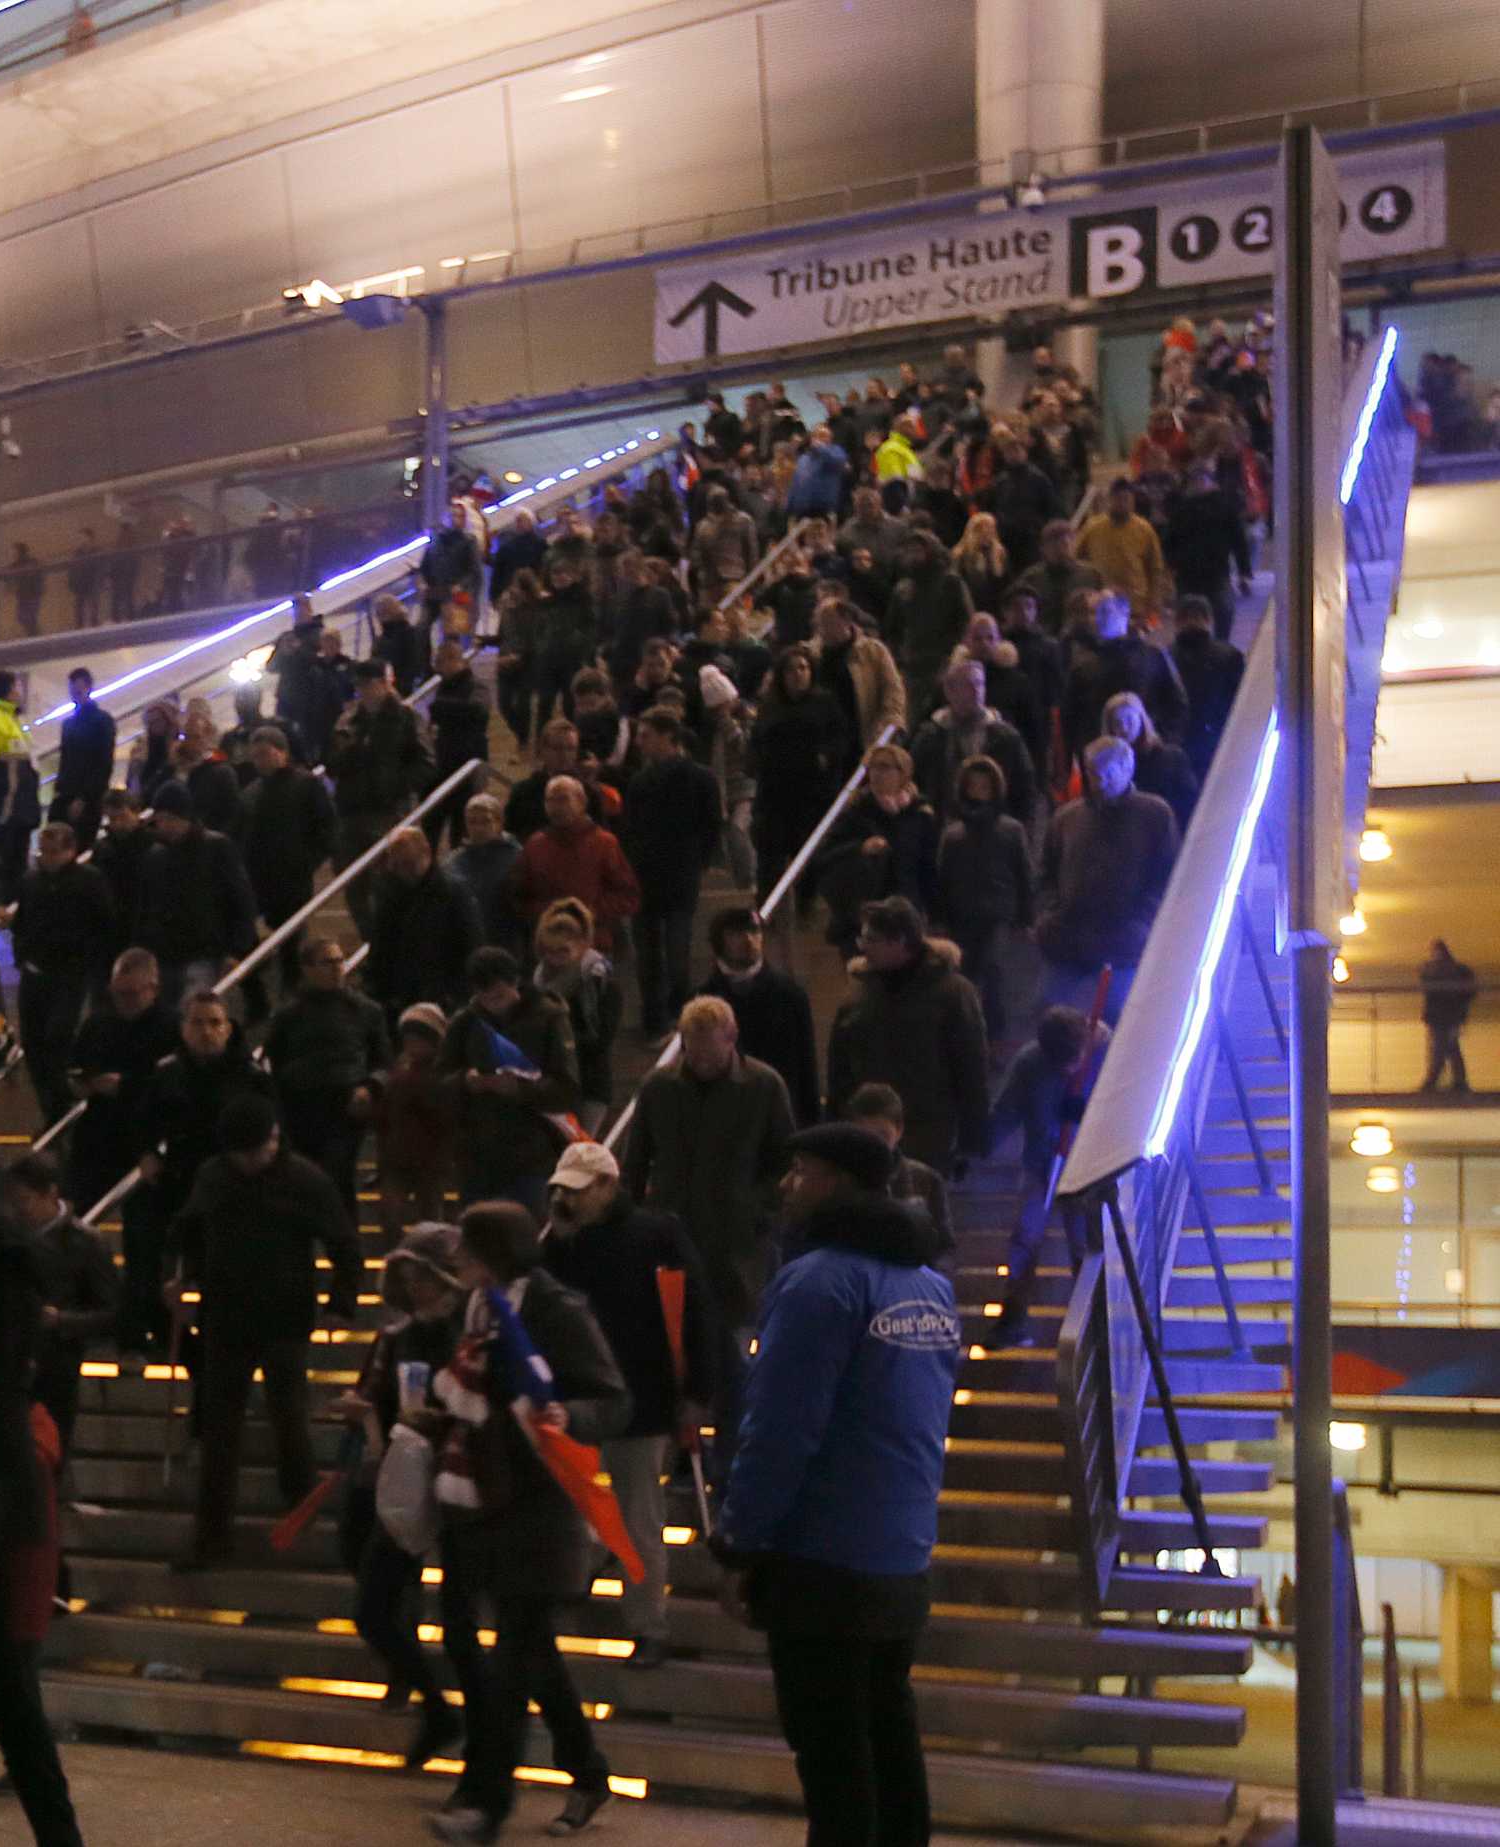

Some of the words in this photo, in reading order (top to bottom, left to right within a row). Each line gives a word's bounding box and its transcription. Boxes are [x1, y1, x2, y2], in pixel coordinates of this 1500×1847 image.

[767, 253, 916, 299] Tribune
[929, 229, 1051, 272] Haute
[1086, 225, 1145, 297] B
[1181, 224, 1199, 254] 1
[1243, 211, 1269, 245] 2
[1368, 190, 1398, 223] 4
[823, 287, 930, 328] Upper
[942, 260, 1053, 308] Stand
